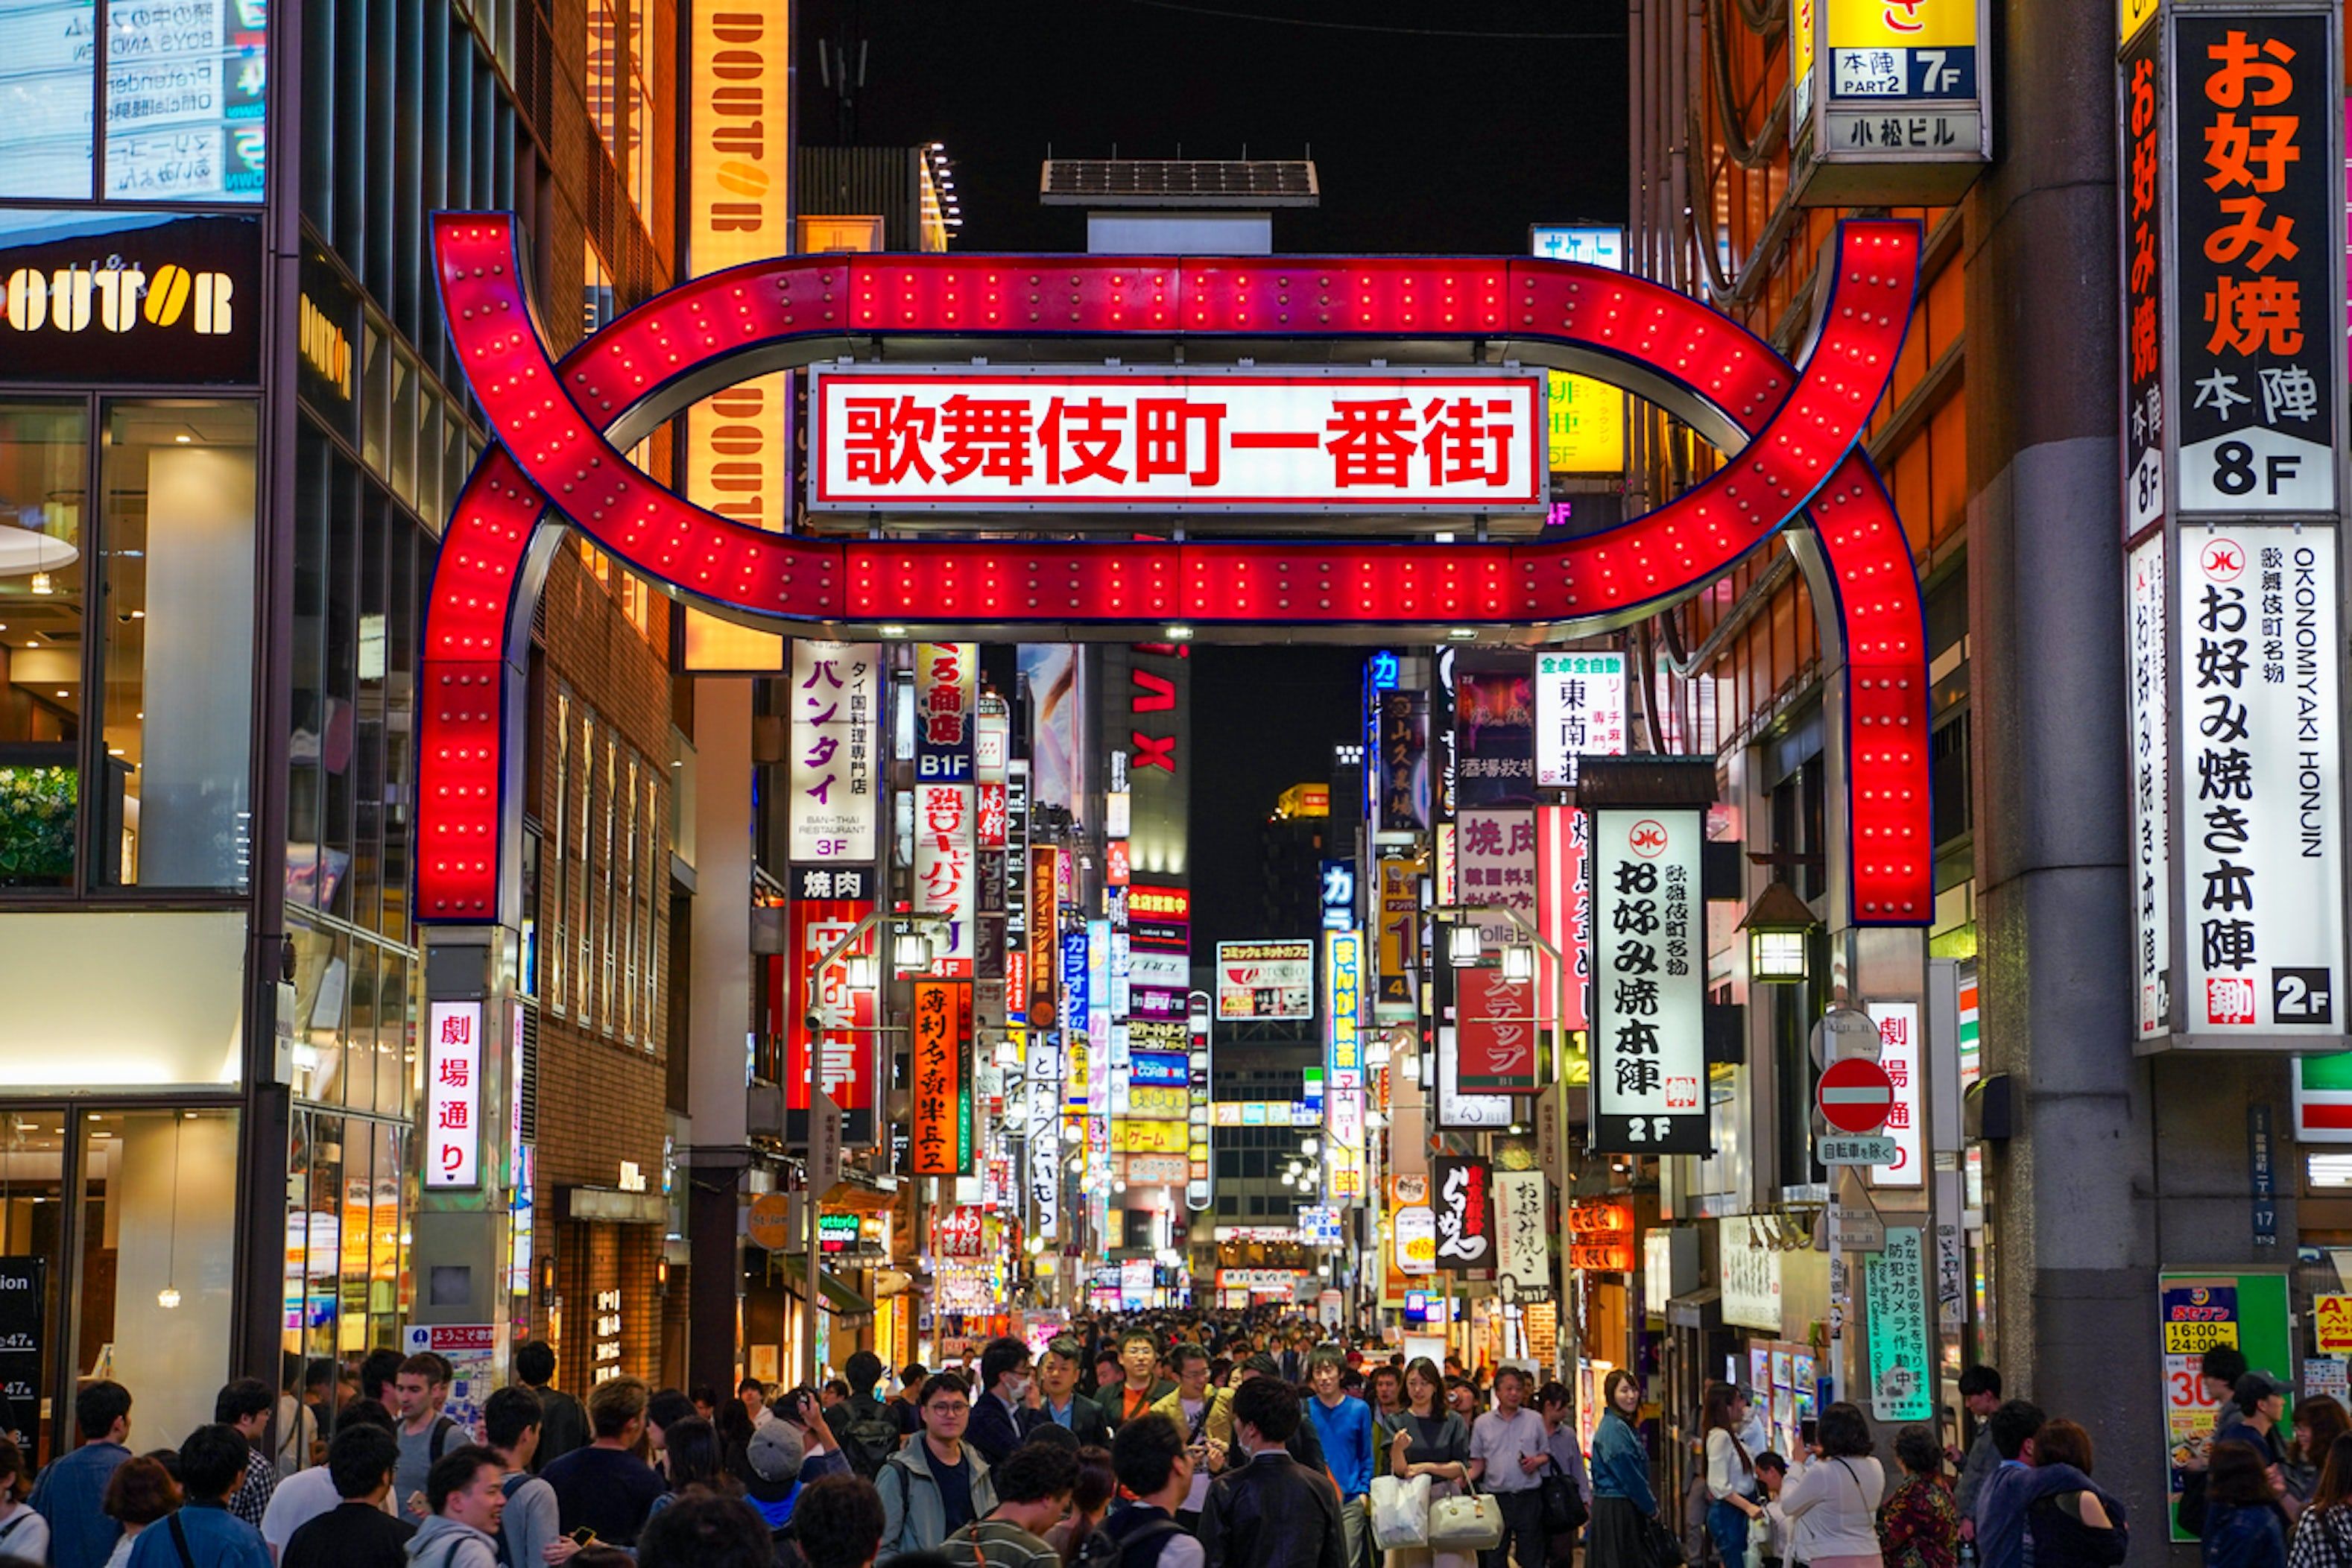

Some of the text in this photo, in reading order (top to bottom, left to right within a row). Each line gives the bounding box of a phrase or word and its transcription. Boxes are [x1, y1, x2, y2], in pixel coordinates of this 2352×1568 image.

[1844, 52, 1894, 75] 本陣
[1916, 50, 1961, 92] 7F
[711, 13, 769, 233] DOUTOR
[1851, 118, 1955, 146] 小松ビル
[2204, 31, 2304, 356] お好み焼
[2131, 58, 2157, 385] お好み焼
[0, 264, 233, 334] OUTOR
[2194, 364, 2317, 423] 本陣
[843, 395, 1514, 487] 歌舞伎町一番街
[2138, 462, 2157, 514] 8F
[2213, 441, 2301, 496] 8F
[2260, 547, 2284, 683] 歌舞伎町名物
[1541, 657, 1621, 674] 全卓全自動
[2294, 547, 2322, 858] OKONOMIYAKI HONJIN
[803, 660, 844, 805] バンタイ
[851, 661, 867, 795] タイ国料理専門店
[920, 754, 968, 776] B1F
[2197, 584, 2257, 972] お好み焼き本陣
[799, 826, 866, 835] RESTAURANT
[816, 840, 848, 856] 3F
[803, 871, 862, 898] 焼肉
[1479, 925, 1529, 942] ollab
[1666, 864, 1689, 976] 歌舞伎町名物
[932, 960, 959, 977] 4F
[1613, 860, 1661, 1096] お好み焼本陣
[1334, 940, 1356, 1068] まんが喫茶
[2277, 976, 2329, 1014] 2F
[439, 1014, 470, 1172] 劇場通り
[1128, 1131, 1165, 1146] ゲーム
[1628, 1119, 1672, 1142] 2F
[1824, 1143, 1890, 1160] 自転車を除く
[2256, 1212, 2274, 1226] 17
[0, 1274, 28, 1290] ion
[1888, 1243, 1910, 1387] 防犯カメラ作動中
[2172, 1306, 2230, 1321] 夜セブン
[2171, 1339, 2218, 1351] 24:00
